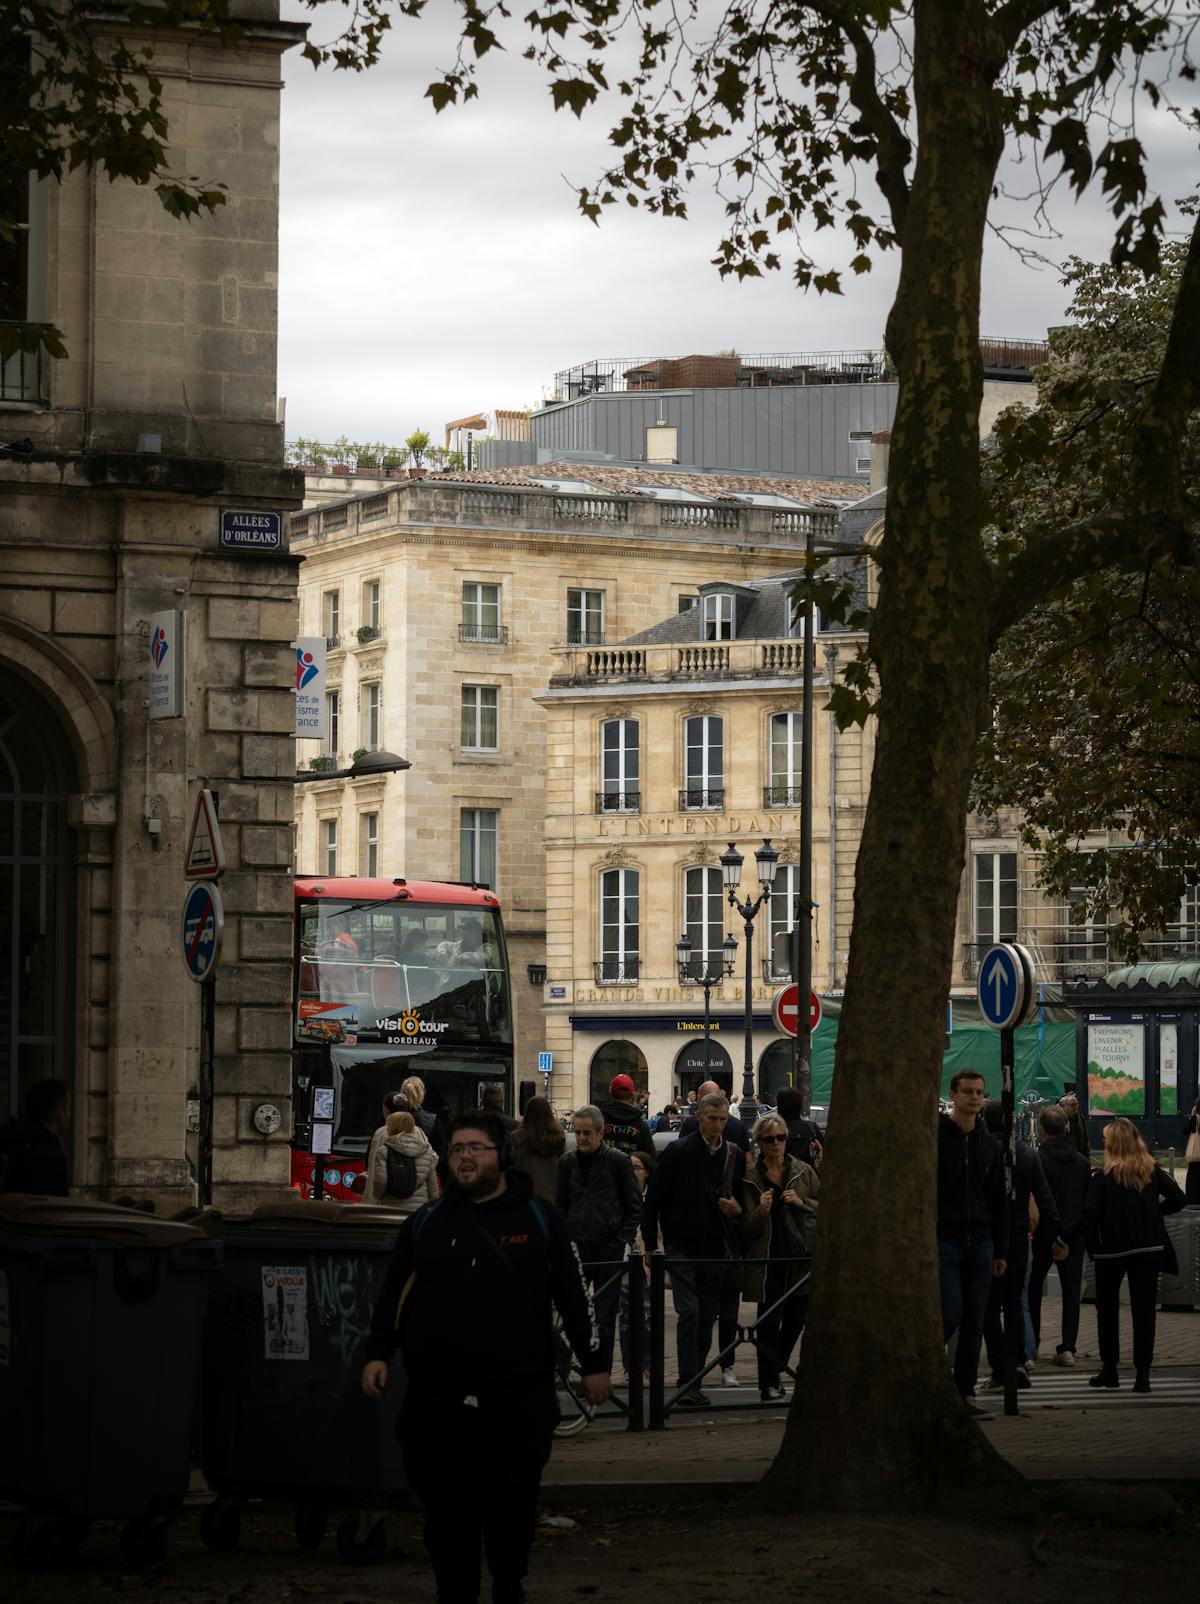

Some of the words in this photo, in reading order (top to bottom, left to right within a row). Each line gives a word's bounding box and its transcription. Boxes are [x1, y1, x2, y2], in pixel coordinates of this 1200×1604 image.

[232, 514, 271, 528] ALLÉES
[224, 529, 278, 544] D'ORLÉANS
[576, 987, 645, 1002] GRANDS
[655, 987, 695, 1001] VINS
[387, 1036, 438, 1046] BORDEAUX
[687, 1059, 724, 1067] L'Intedant
